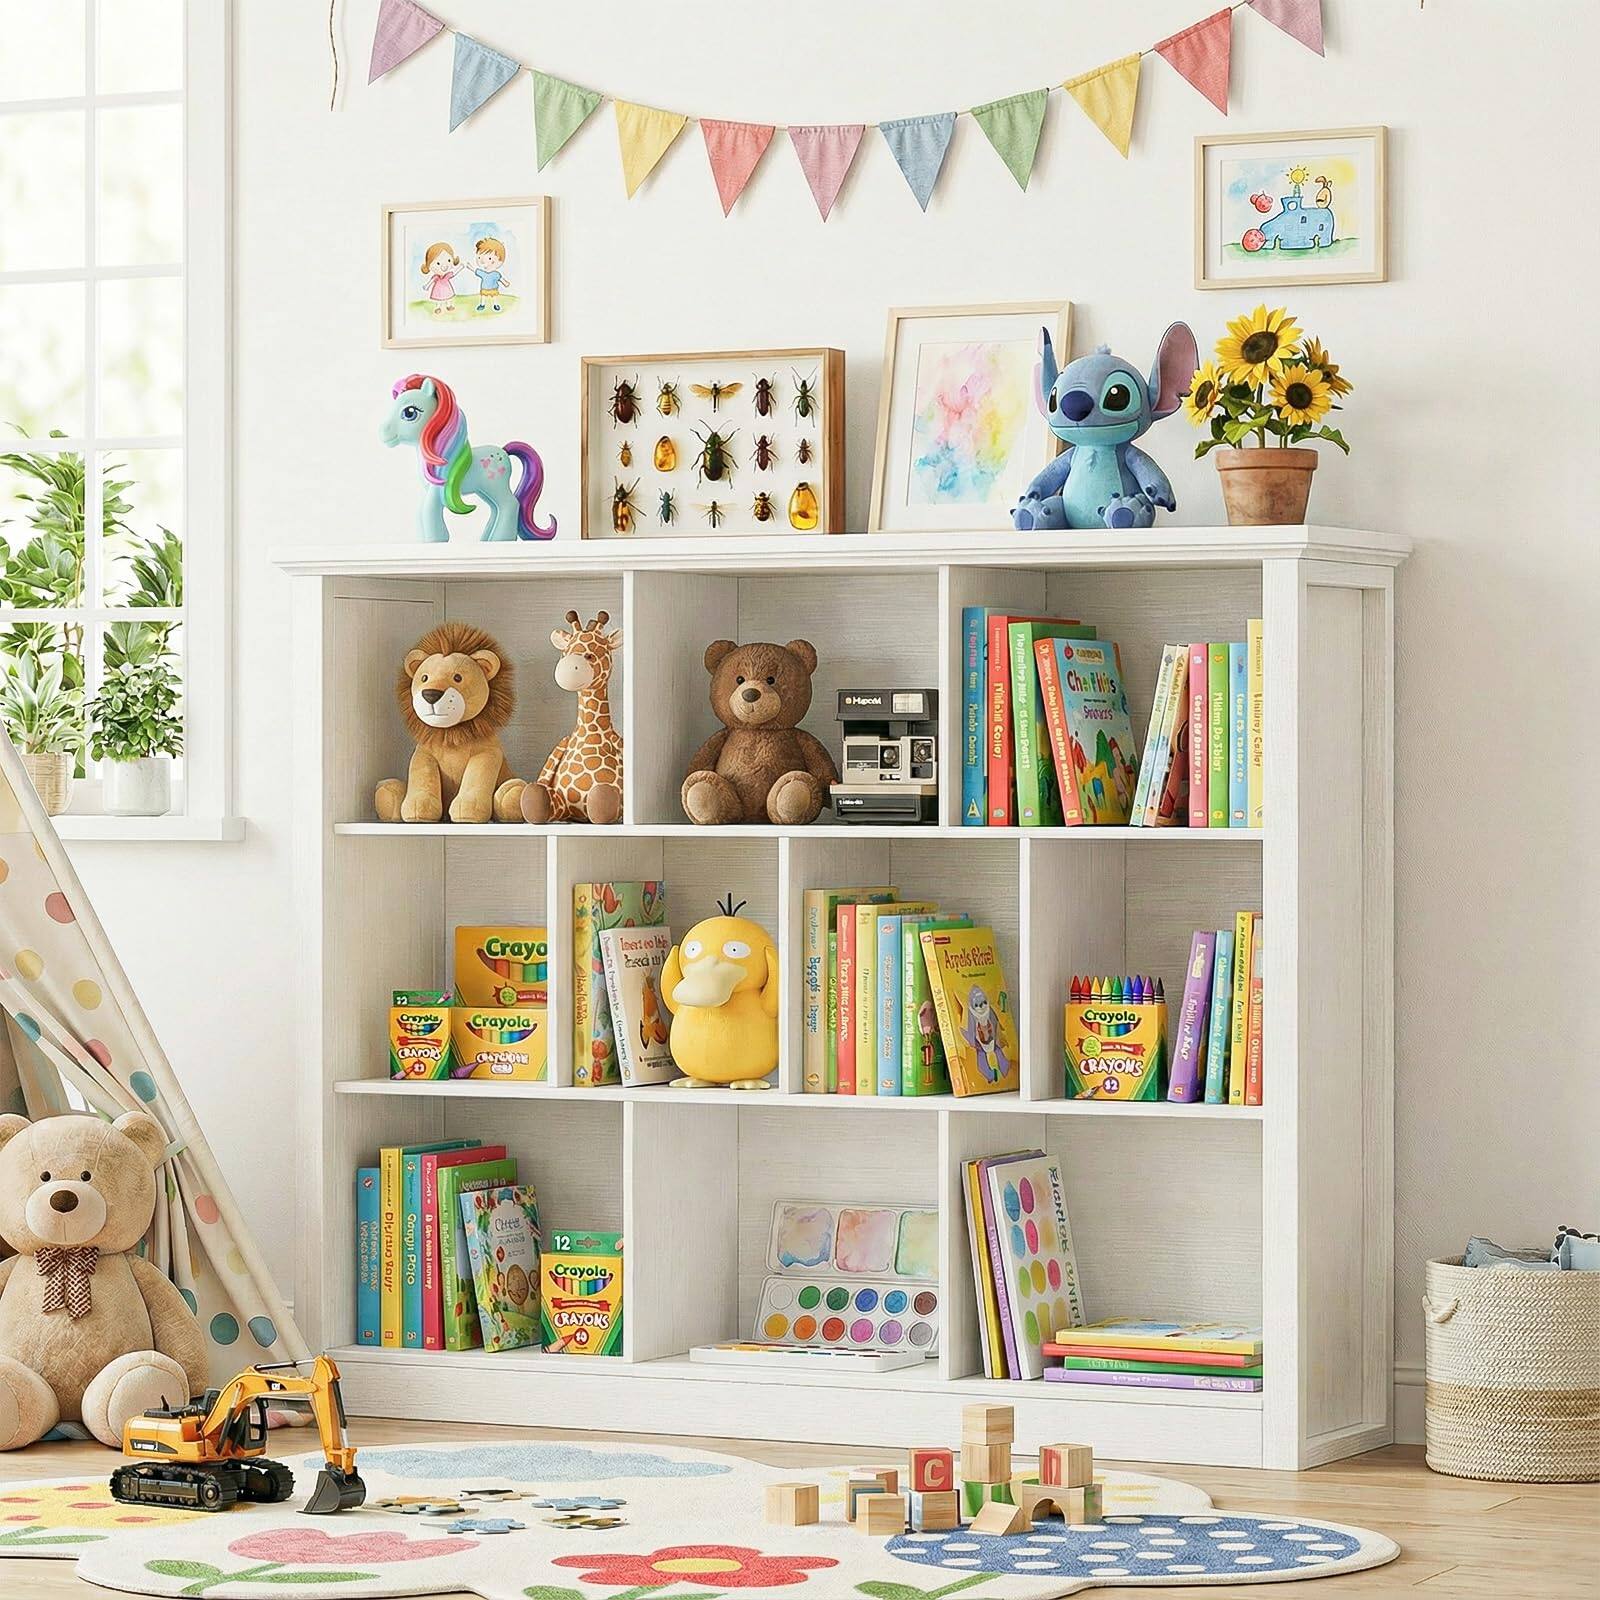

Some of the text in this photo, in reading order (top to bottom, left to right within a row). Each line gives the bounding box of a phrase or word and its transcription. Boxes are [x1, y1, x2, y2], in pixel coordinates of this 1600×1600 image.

[472, 1014, 531, 1030] Crayola
[1080, 1056, 1144, 1077] CRAYONS
[554, 1235, 571, 1251] 12
[554, 1263, 607, 1278] Crayola
[554, 1311, 610, 1330] CRAYONS
[924, 1458, 945, 1487] C
